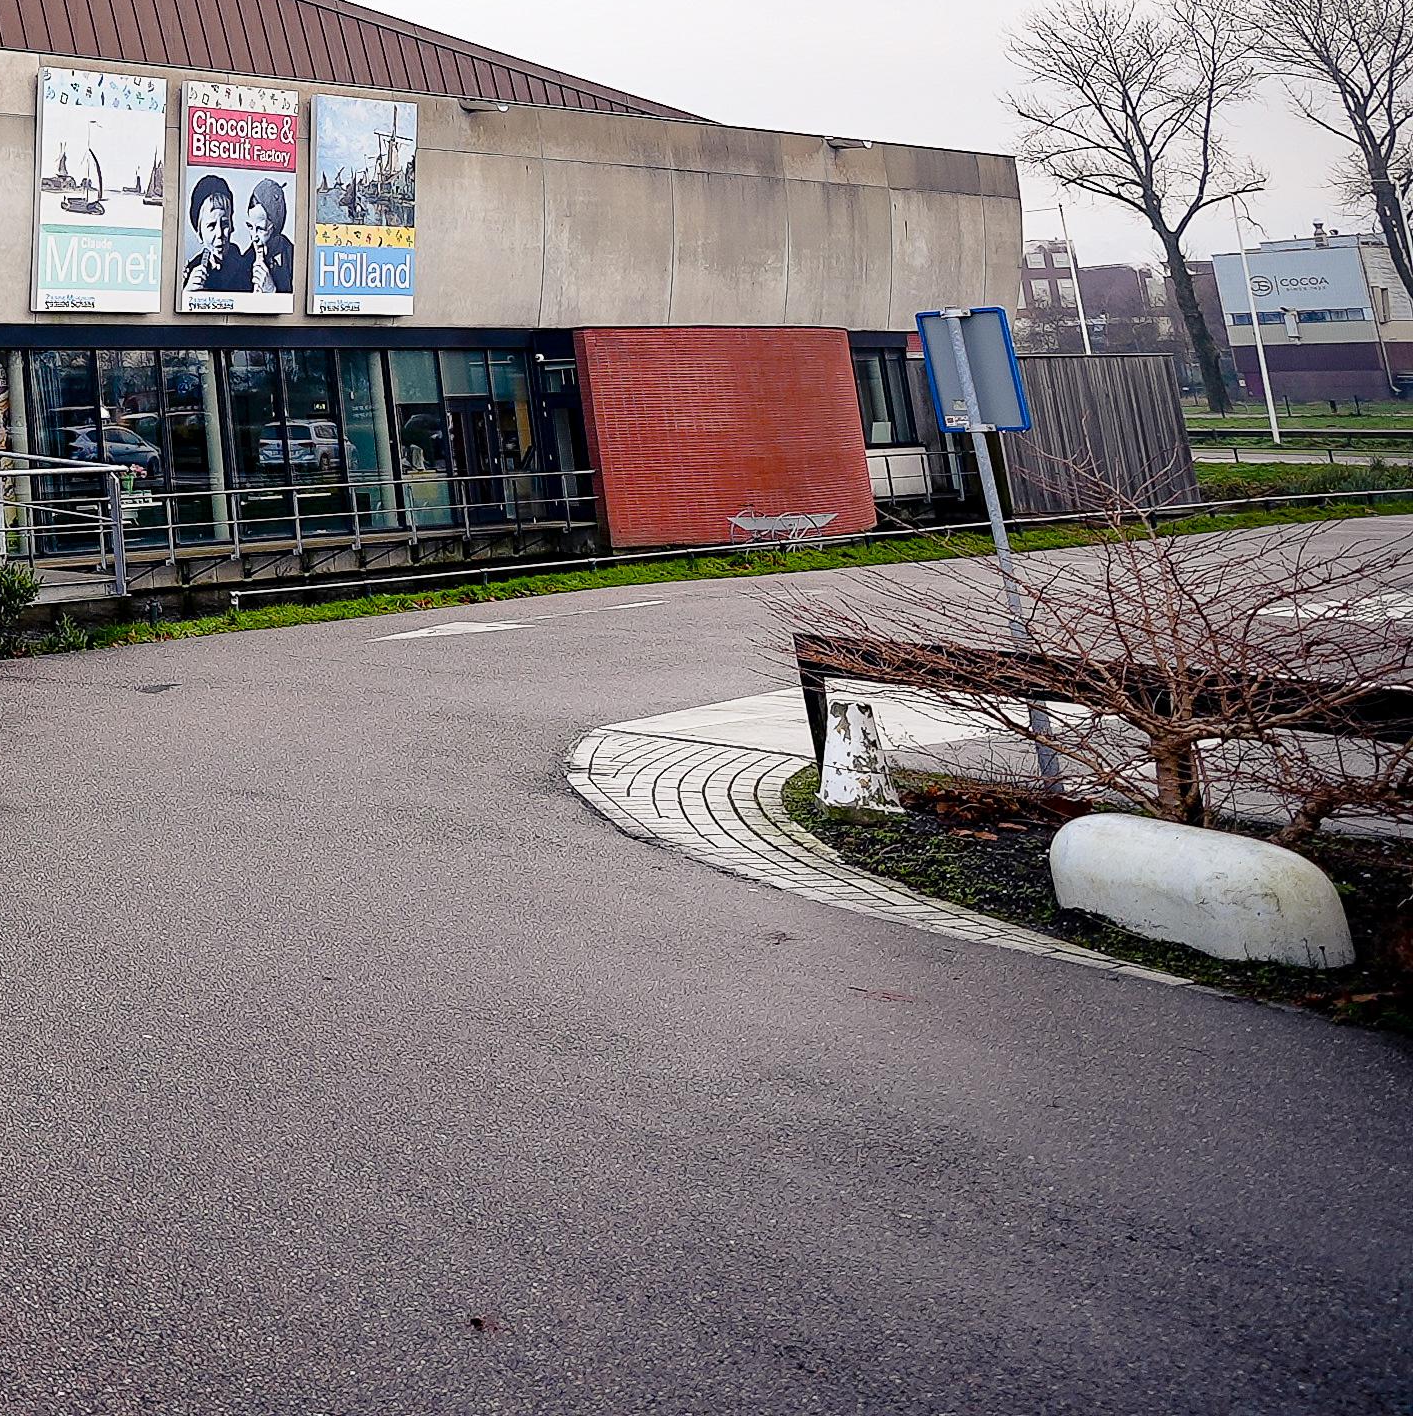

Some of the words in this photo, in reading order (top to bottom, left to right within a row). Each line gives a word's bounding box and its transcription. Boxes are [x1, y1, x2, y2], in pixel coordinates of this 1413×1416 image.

[193, 110, 278, 140] Chocolate
[280, 116, 295, 144] &
[192, 133, 251, 161] Biscuit
[253, 145, 291, 167] Factory
[45, 236, 158, 285] Monet
[319, 251, 411, 289] Holland
[1279, 276, 1330, 287] COCOA
